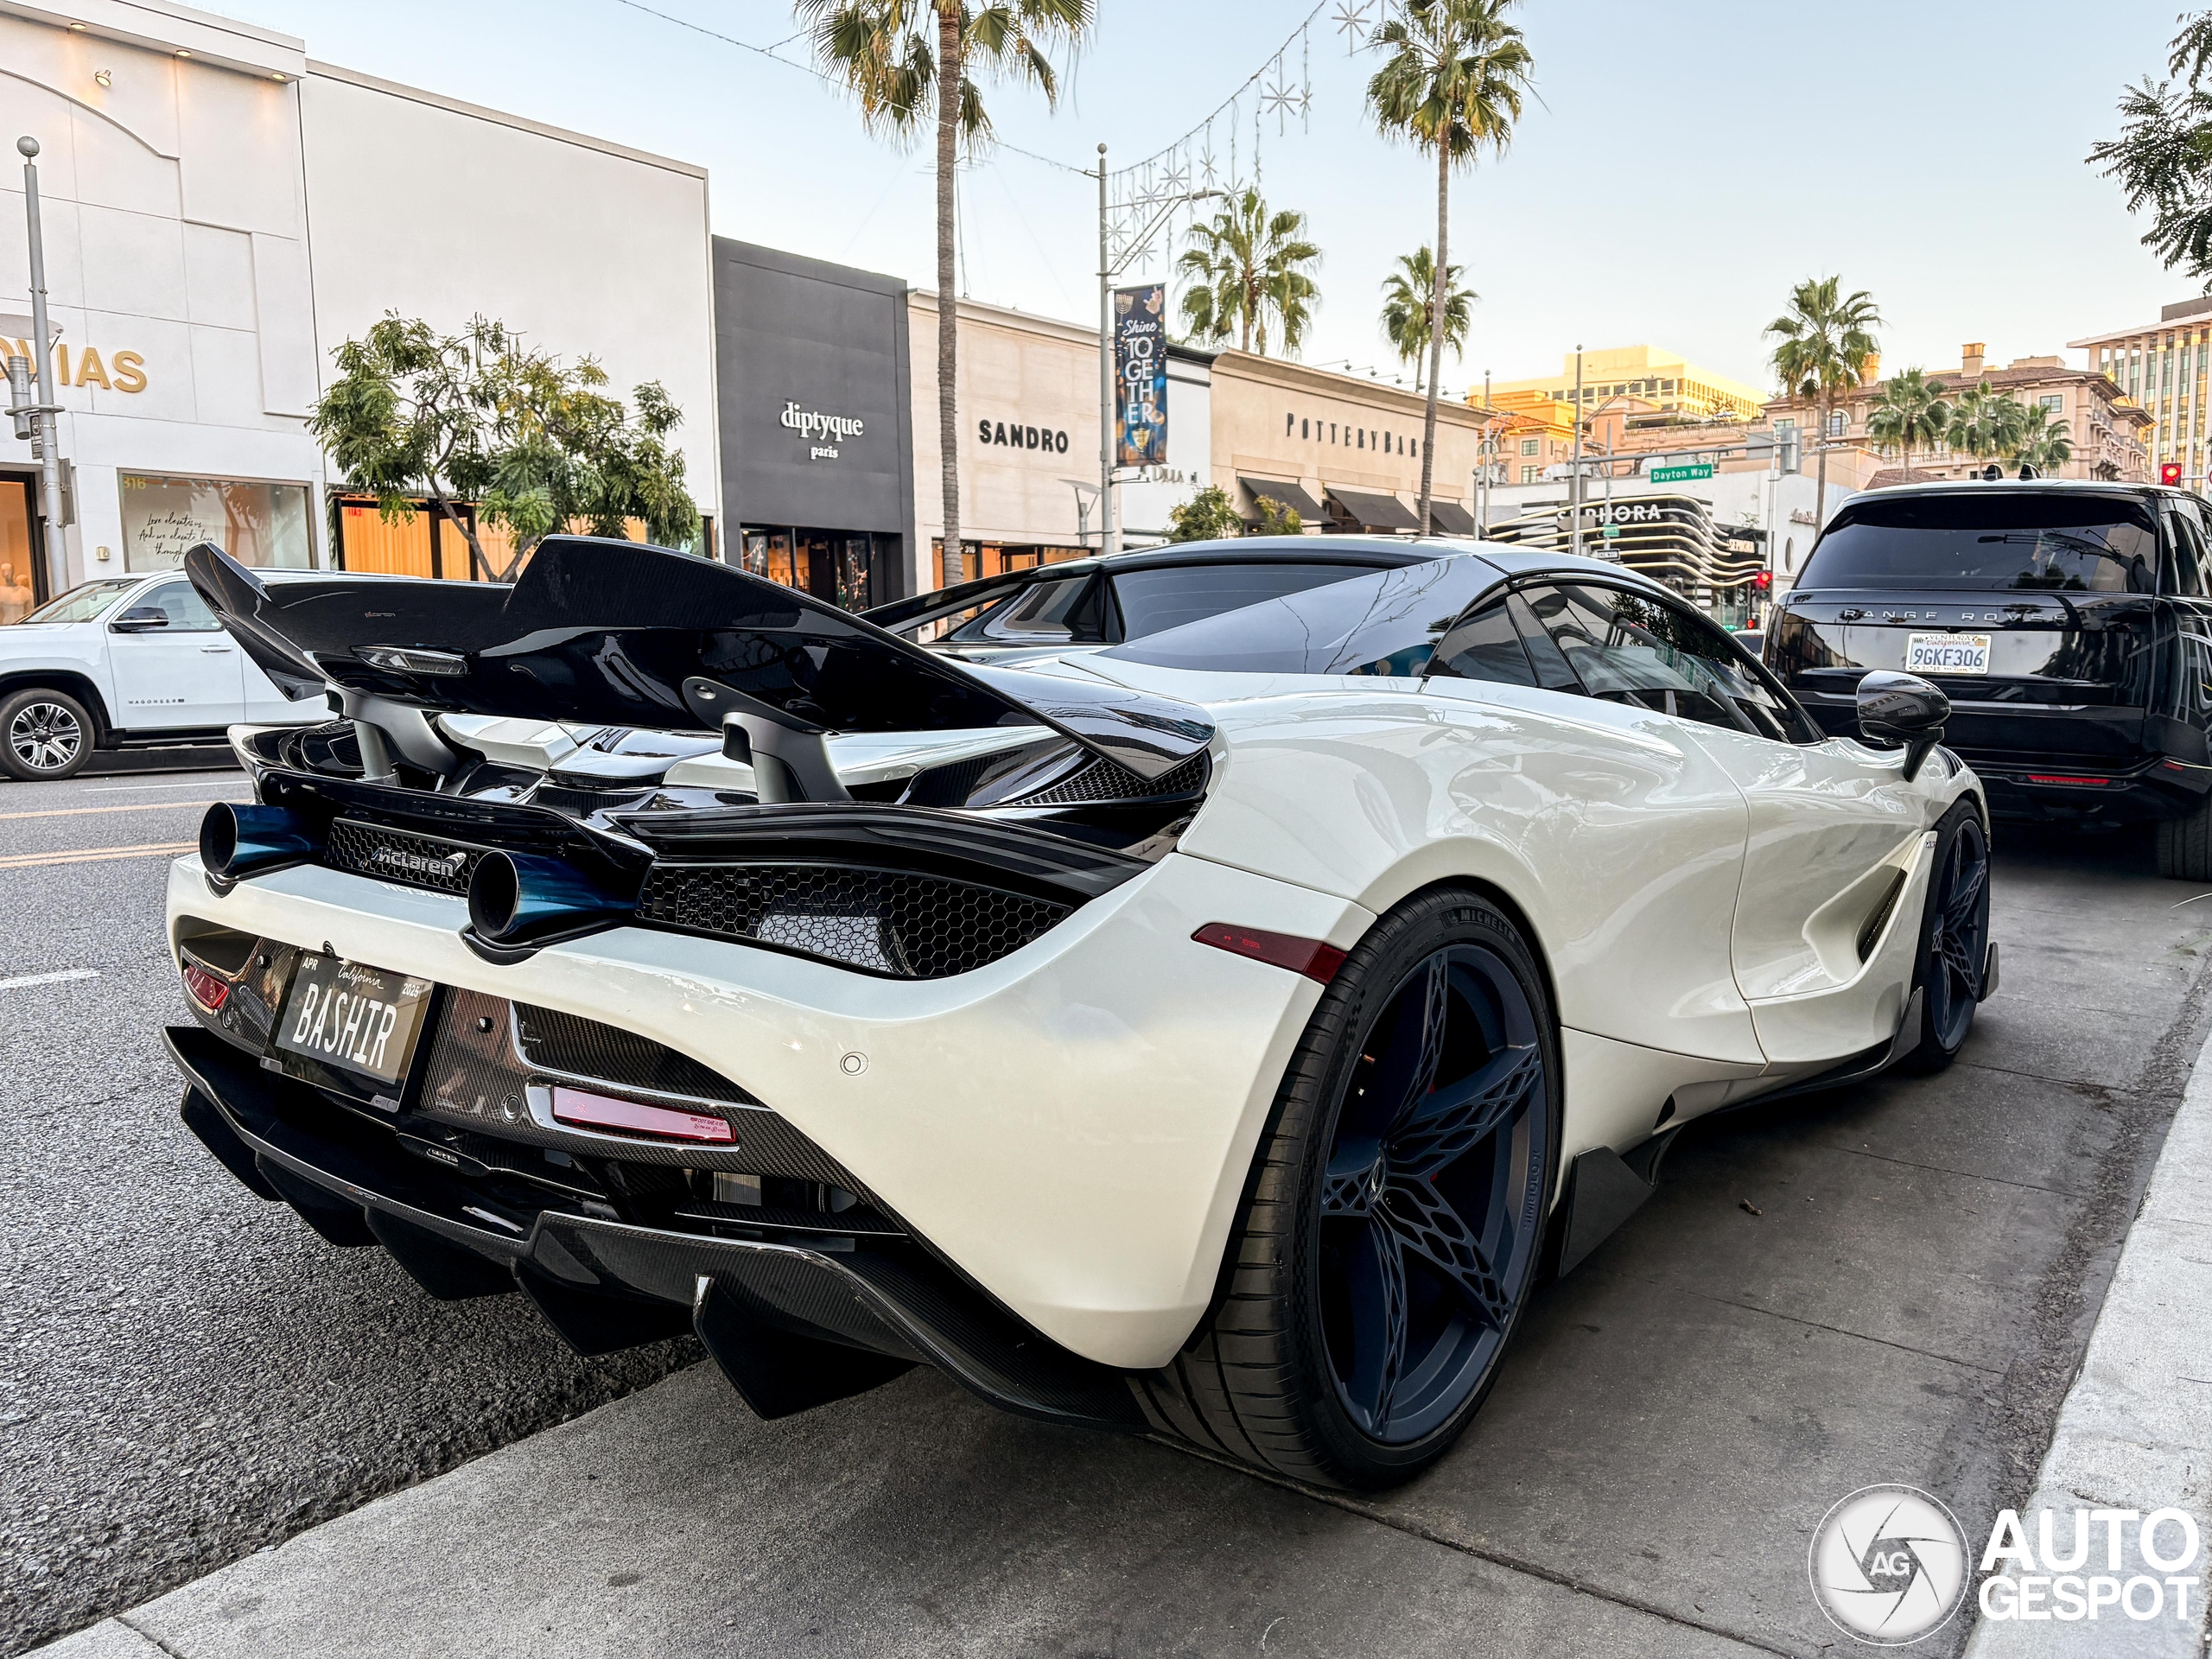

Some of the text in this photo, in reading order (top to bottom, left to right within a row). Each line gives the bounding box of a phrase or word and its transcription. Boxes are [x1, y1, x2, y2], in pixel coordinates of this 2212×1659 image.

[1122, 320, 1158, 336] Shine
[1127, 336, 1153, 359] TO
[1125, 359, 1154, 381] GE
[1126, 381, 1154, 403] TH
[780, 402, 863, 442] diptyque
[1128, 402, 1154, 424] ER
[979, 419, 1068, 454] SANDRO
[810, 446, 838, 460] paris
[1653, 467, 1710, 480] Dayton Way
[1557, 504, 1661, 524] SPHORA
[1843, 608, 2069, 624] RANGE ROVER
[1913, 648, 1985, 667] 9GKF306
[371, 847, 454, 878] McLaren
[1459, 908, 1516, 943] MICHELIN
[302, 957, 420, 998] APR California 2025
[292, 982, 397, 1070] BASHIR
